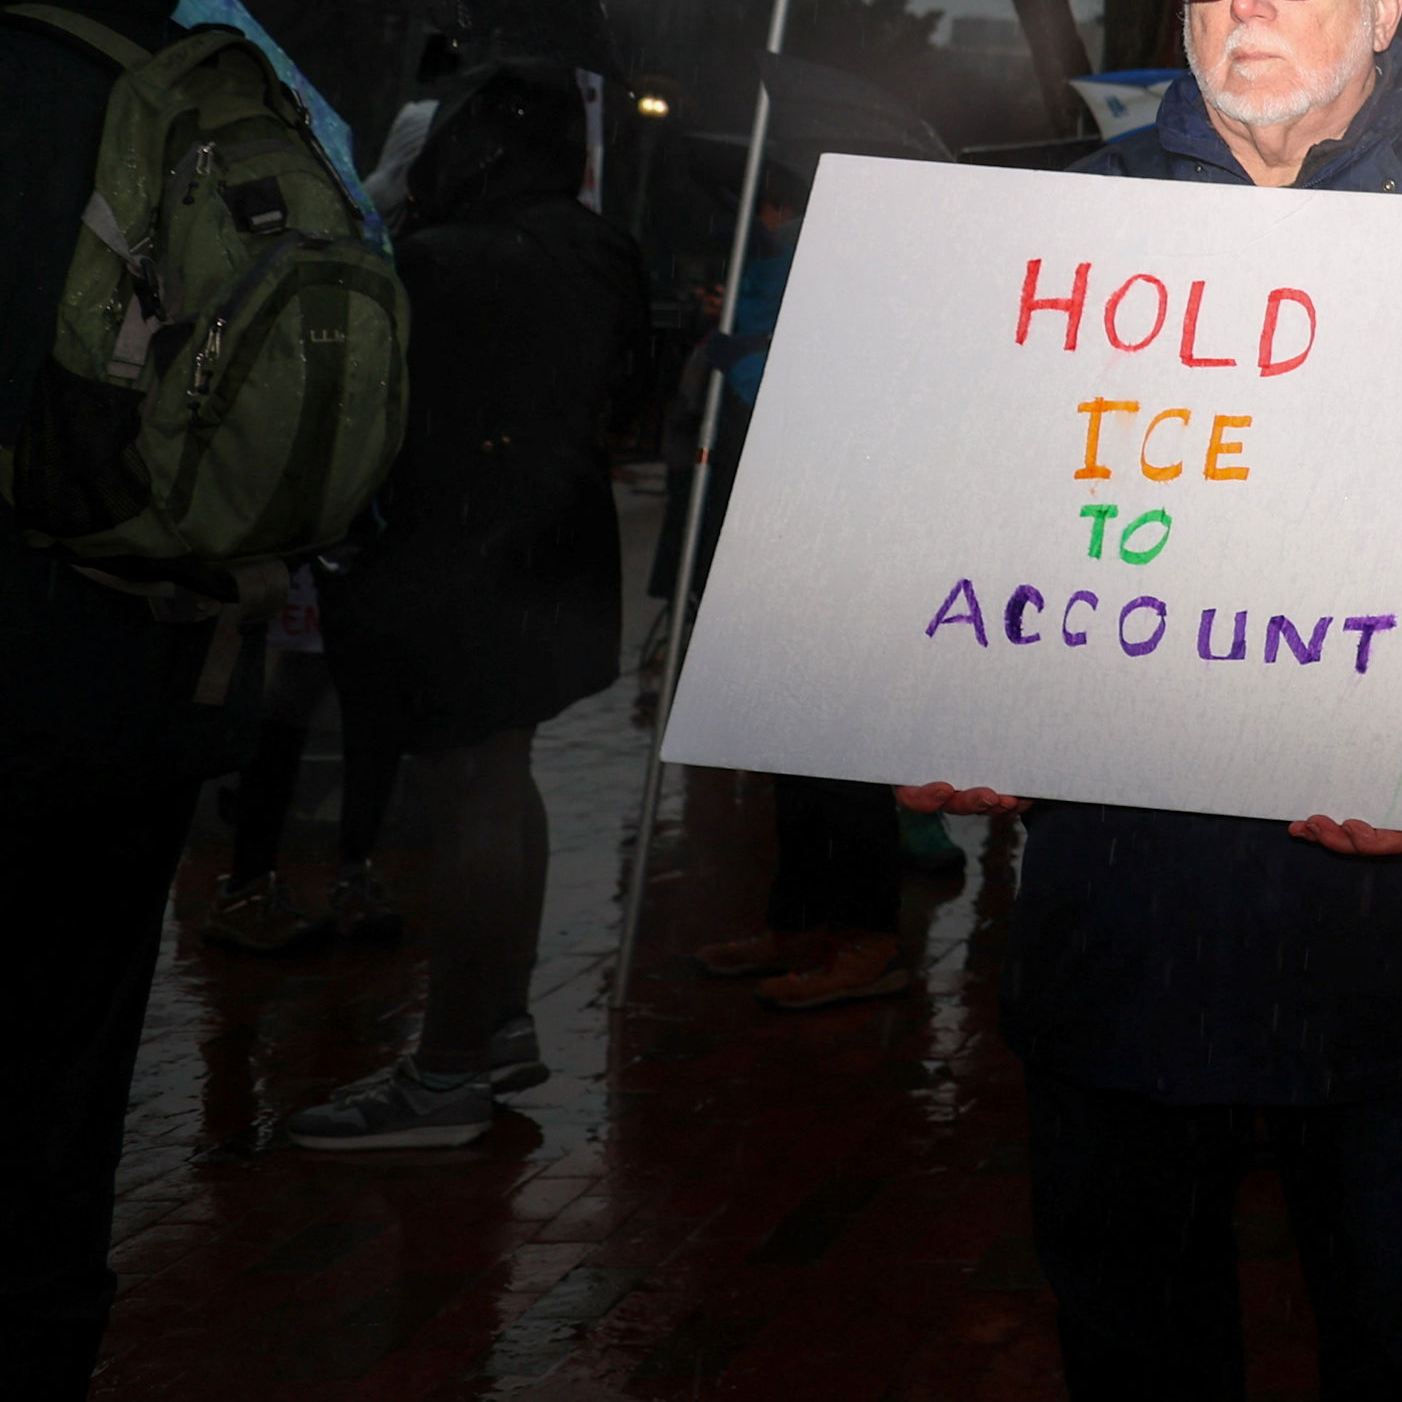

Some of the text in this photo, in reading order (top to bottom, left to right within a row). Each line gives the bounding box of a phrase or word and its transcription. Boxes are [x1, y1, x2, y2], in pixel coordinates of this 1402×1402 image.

[1015, 258, 1317, 378] HOLD
[1074, 397, 1253, 482] ICE
[1079, 504, 1172, 565] TO
